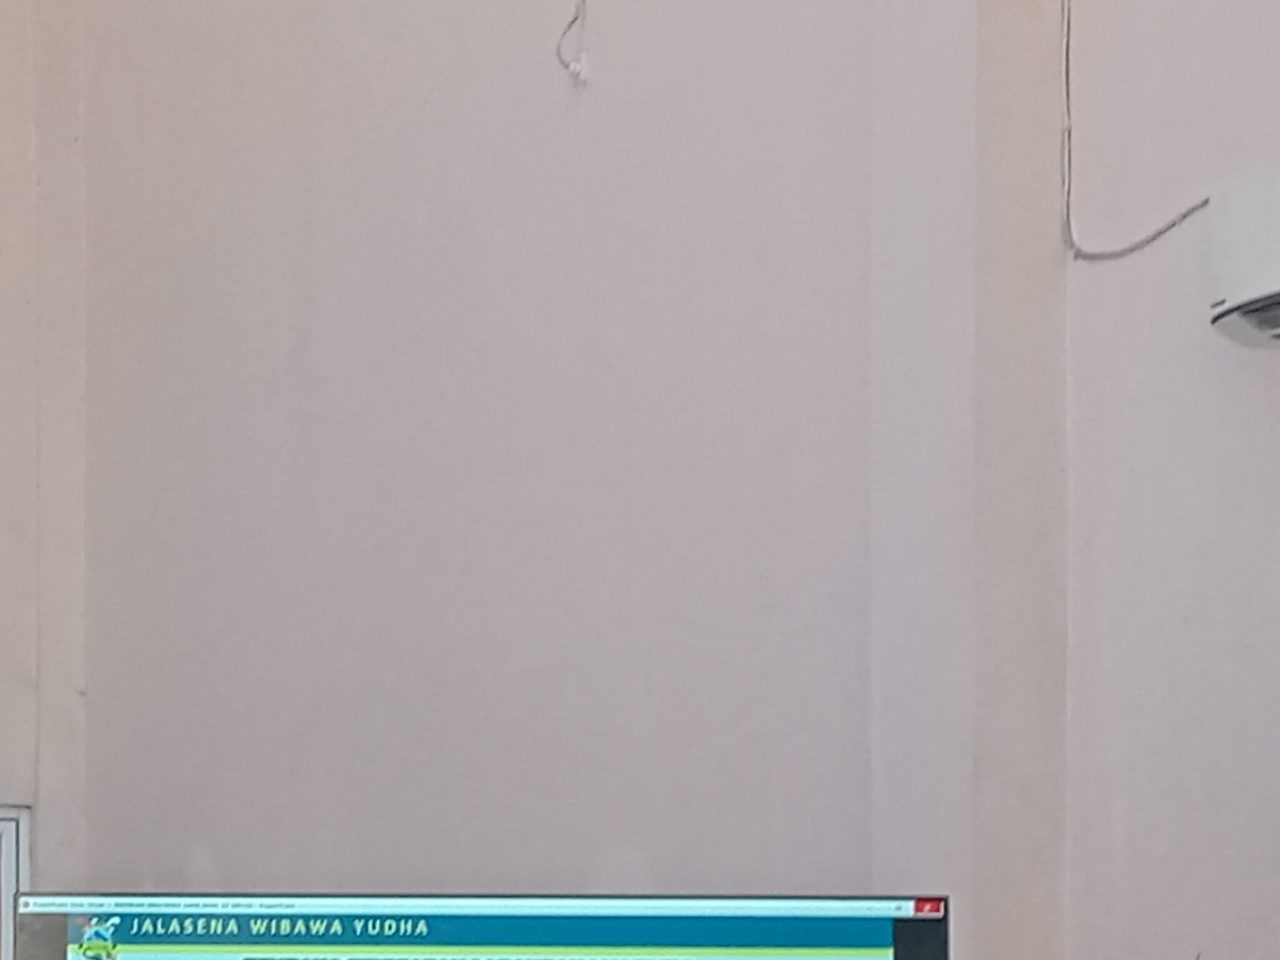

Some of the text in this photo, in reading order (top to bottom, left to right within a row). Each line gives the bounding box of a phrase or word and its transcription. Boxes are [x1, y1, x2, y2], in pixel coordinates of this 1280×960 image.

[129, 917, 430, 937] JALASENA WIBAWA YUDHA
